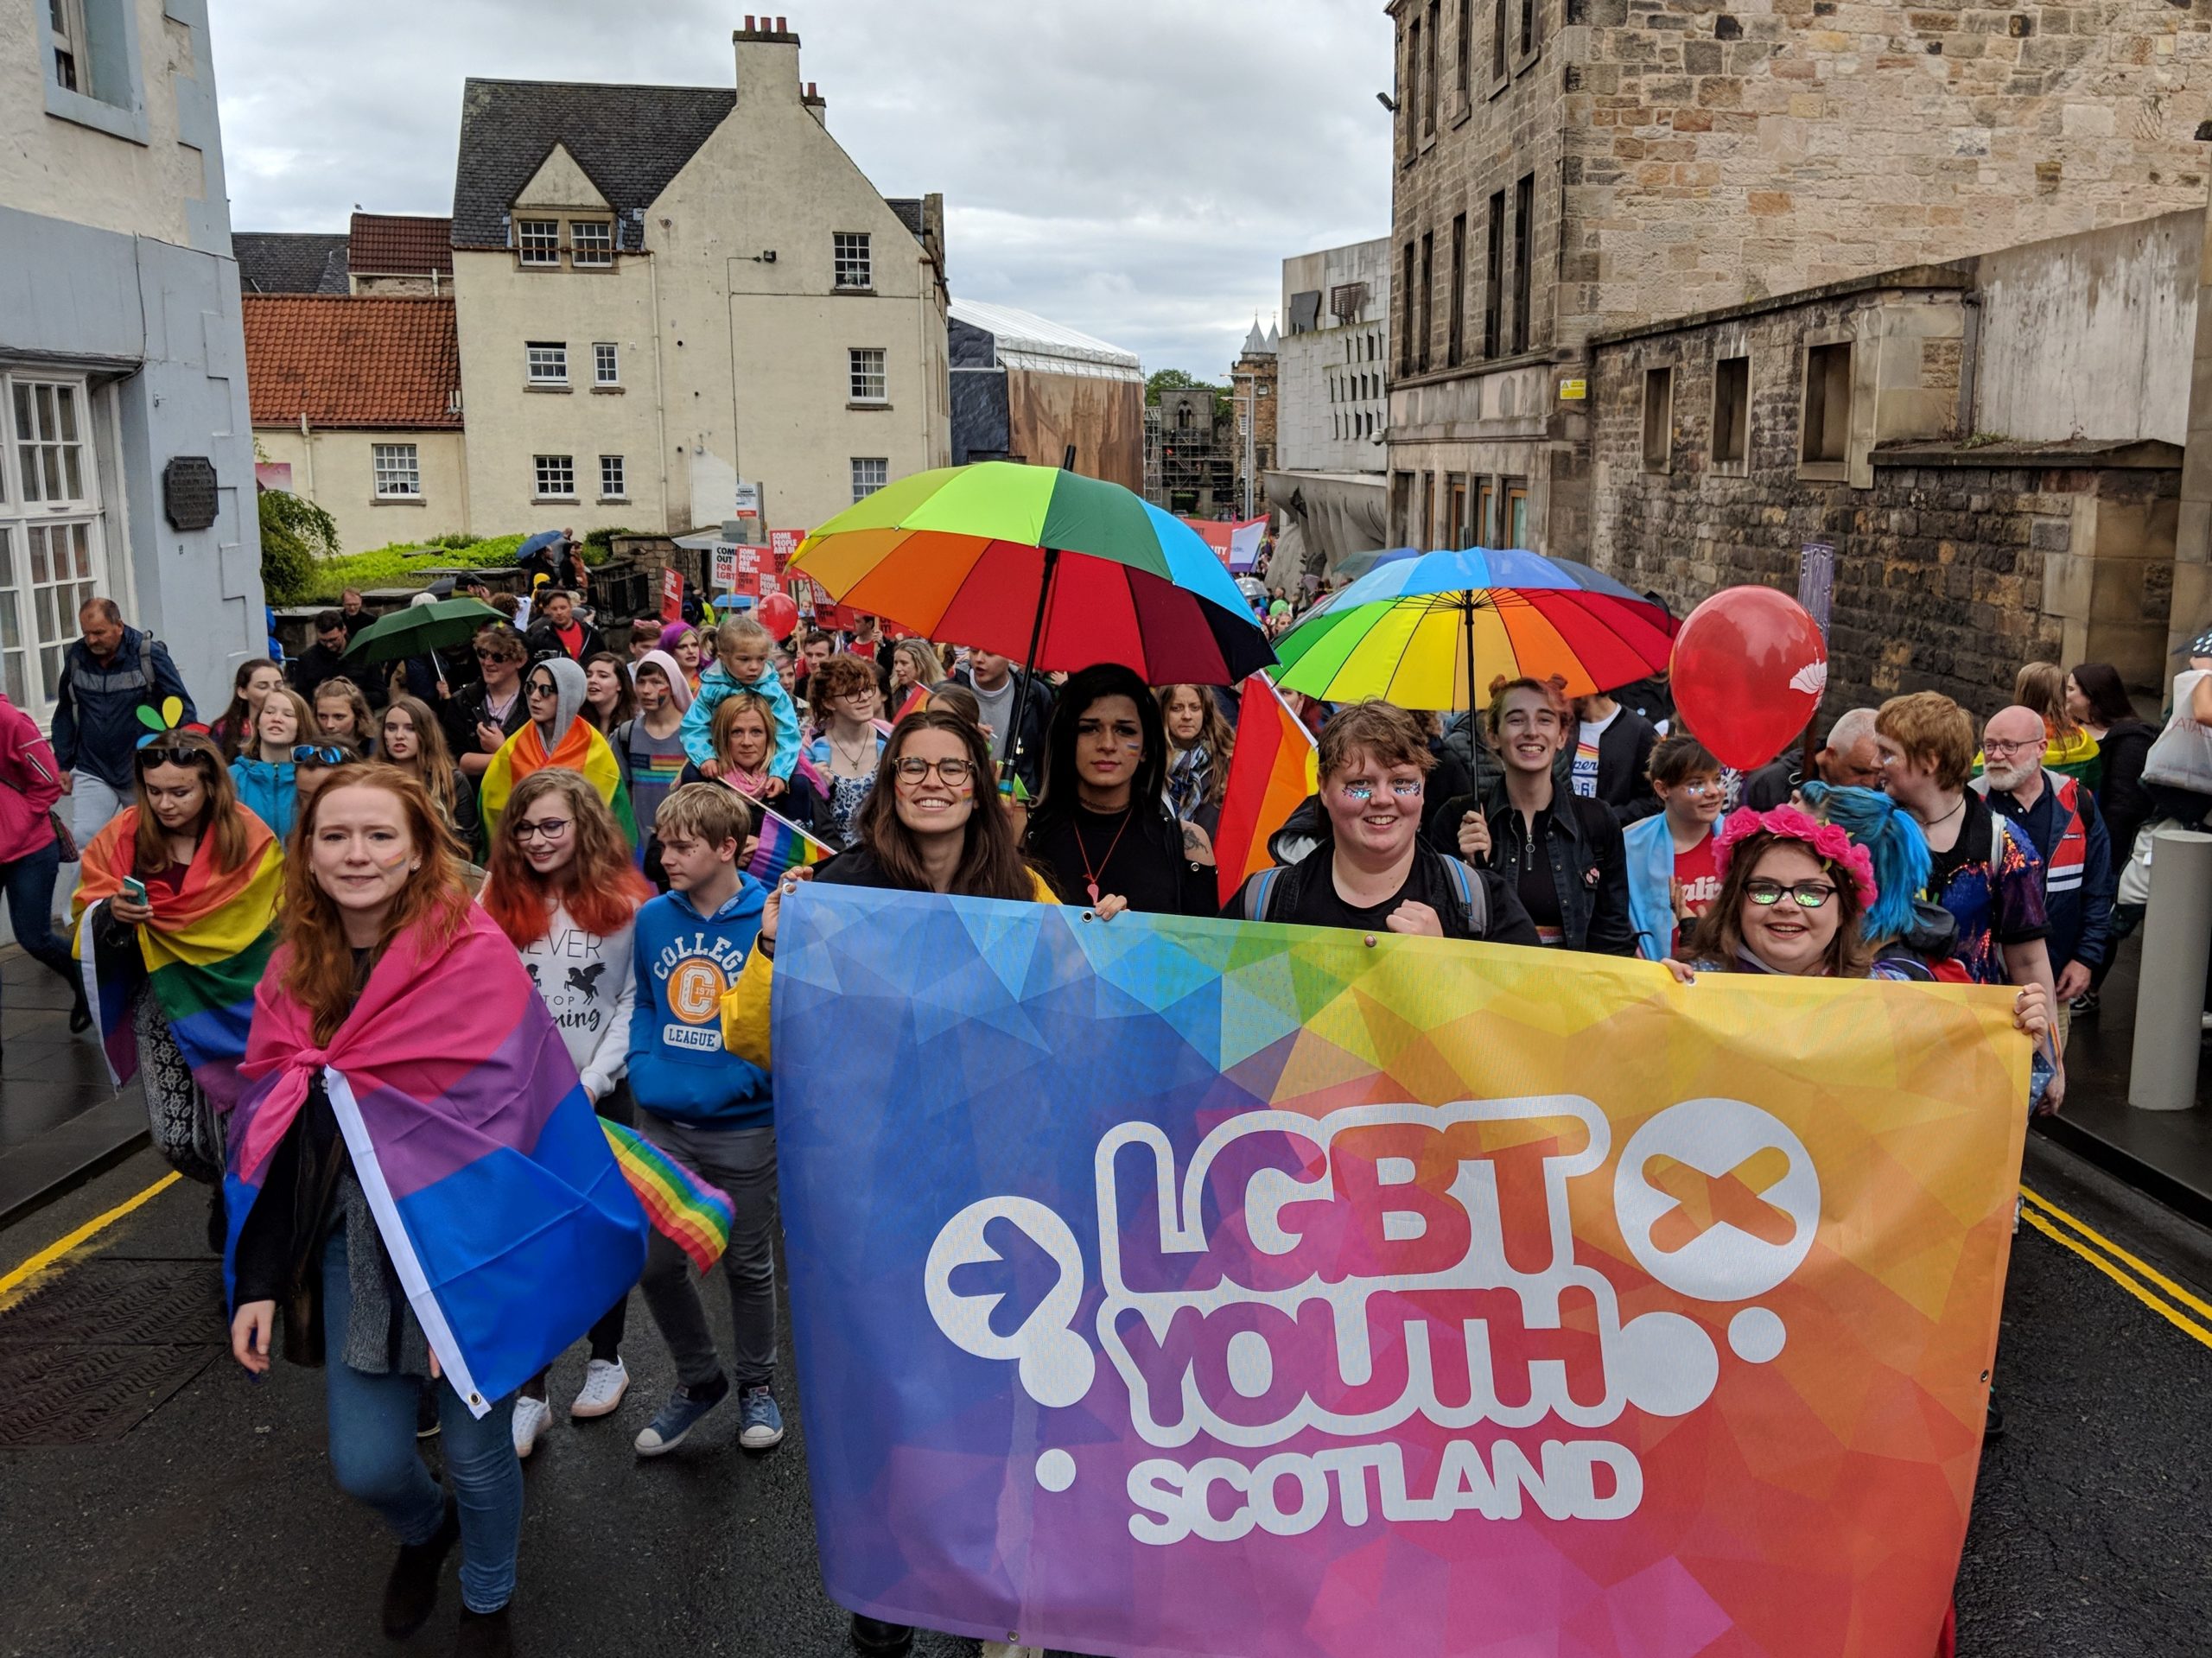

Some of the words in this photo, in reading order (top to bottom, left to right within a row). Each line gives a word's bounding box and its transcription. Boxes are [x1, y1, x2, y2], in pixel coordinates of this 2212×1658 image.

[760, 573, 775, 581] SOME
[760, 581, 780, 591] PEOPLE
[543, 994, 575, 1006] TOP
[668, 1028, 716, 1047] LEAGUE
[1104, 1104, 1600, 1295] LGBT
[1106, 1277, 1614, 1436] YOUTH
[1127, 1439, 1643, 1545] SCOTLAND
